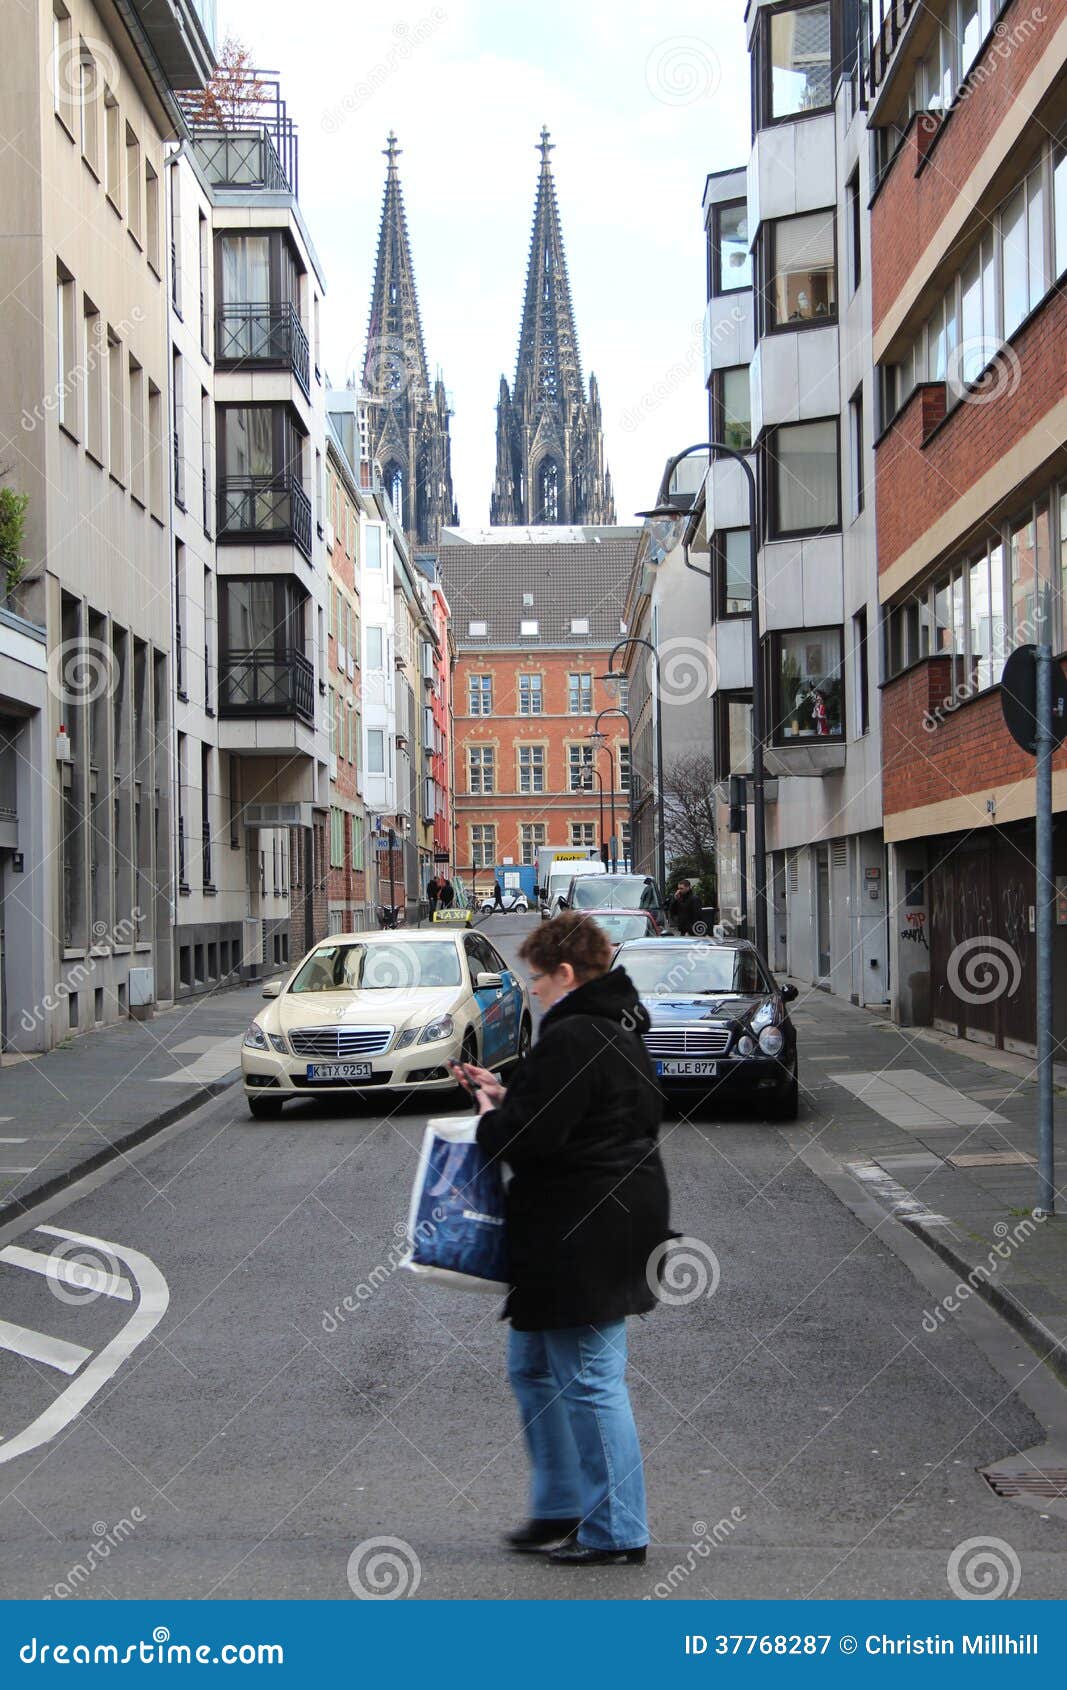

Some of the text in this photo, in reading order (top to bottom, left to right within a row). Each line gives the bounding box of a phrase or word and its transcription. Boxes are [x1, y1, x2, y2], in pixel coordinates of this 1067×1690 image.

[313, 1065, 369, 1077] K TX 9251
[663, 1063, 715, 1073] K LE 877
